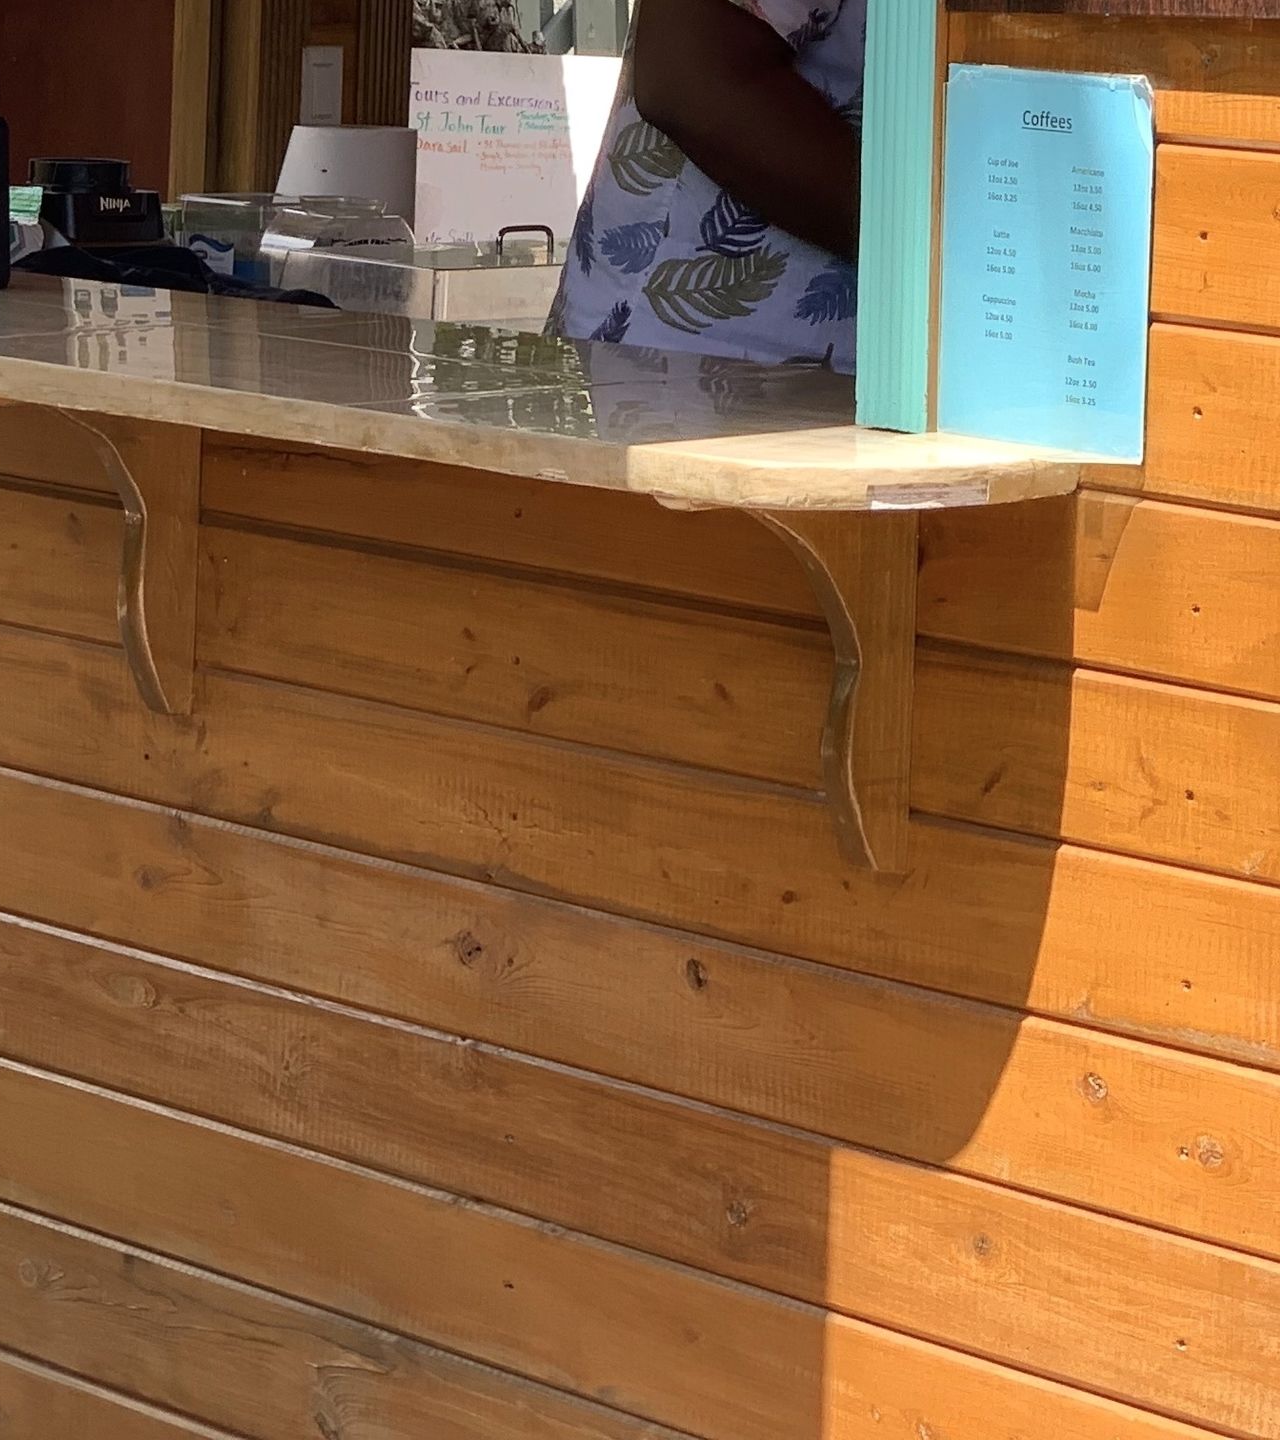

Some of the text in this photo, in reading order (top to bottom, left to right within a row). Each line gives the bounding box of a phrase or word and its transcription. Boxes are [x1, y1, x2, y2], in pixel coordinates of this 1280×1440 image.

[456, 91, 481, 106] and
[440, 111, 473, 133] John
[475, 114, 506, 135] Tour
[1022, 109, 1072, 131] Coffees
[987, 157, 999, 167] Cup
[1000, 158, 1007, 166] of
[100, 196, 131, 213] NINJA
[1084, 357, 1095, 366] Tea
